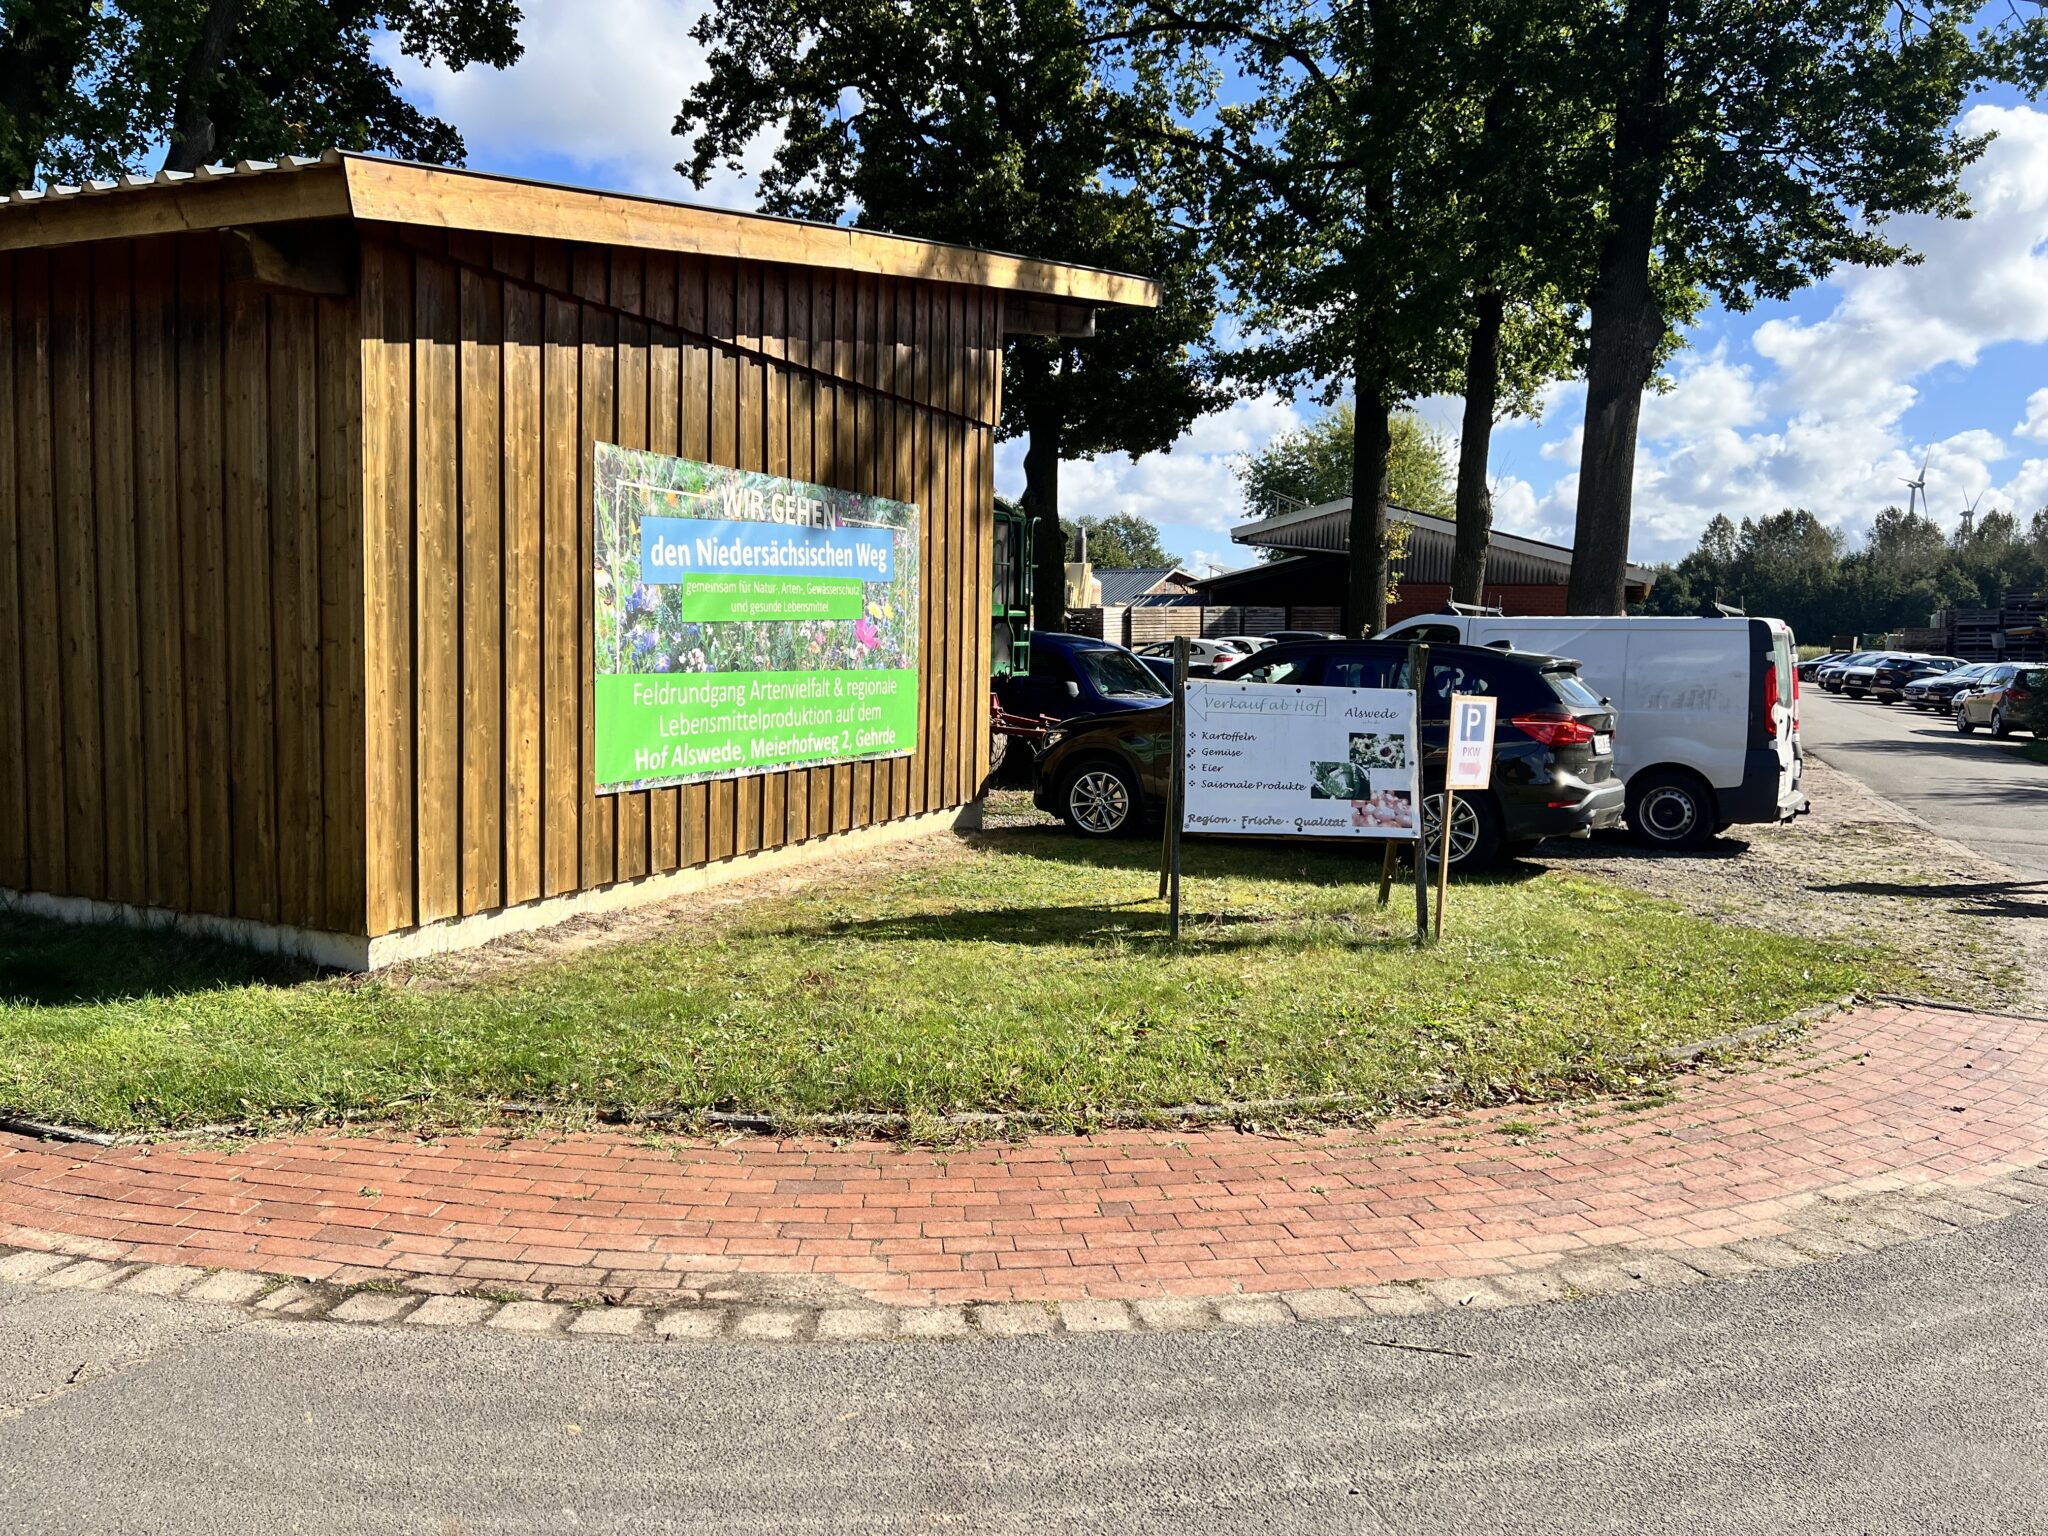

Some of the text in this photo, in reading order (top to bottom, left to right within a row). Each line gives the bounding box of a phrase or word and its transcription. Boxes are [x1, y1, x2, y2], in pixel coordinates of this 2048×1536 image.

[721, 484, 837, 531] WIR GEHEN
[650, 535, 888, 573] den Niedersächsischen Weg
[685, 581, 737, 596] gemeinsam
[739, 580, 751, 593] für
[806, 582, 860, 596] Gewässerschutz
[731, 600, 829, 615] und gesunde Lebensmittel
[633, 676, 897, 708] Feldrundgang Artenvielfalt & regionale
[1204, 696, 1267, 712] Verkauf
[1269, 698, 1289, 711] ab
[659, 702, 882, 737] Lebensmittelproduktion auf dem
[1344, 706, 1400, 719] Alswede
[1466, 708, 1481, 737] P
[1201, 731, 1257, 742] Kartoffeln
[634, 726, 896, 772] Hof Alswede, Meierhofweg 2, Gehrde
[1201, 747, 1243, 757] Gemüse
[1462, 747, 1481, 757] PKW
[1201, 763, 1224, 772] Eier
[1201, 779, 1307, 791] Saisonale Produkte
[1187, 813, 1349, 829] Region Frische Qualität
